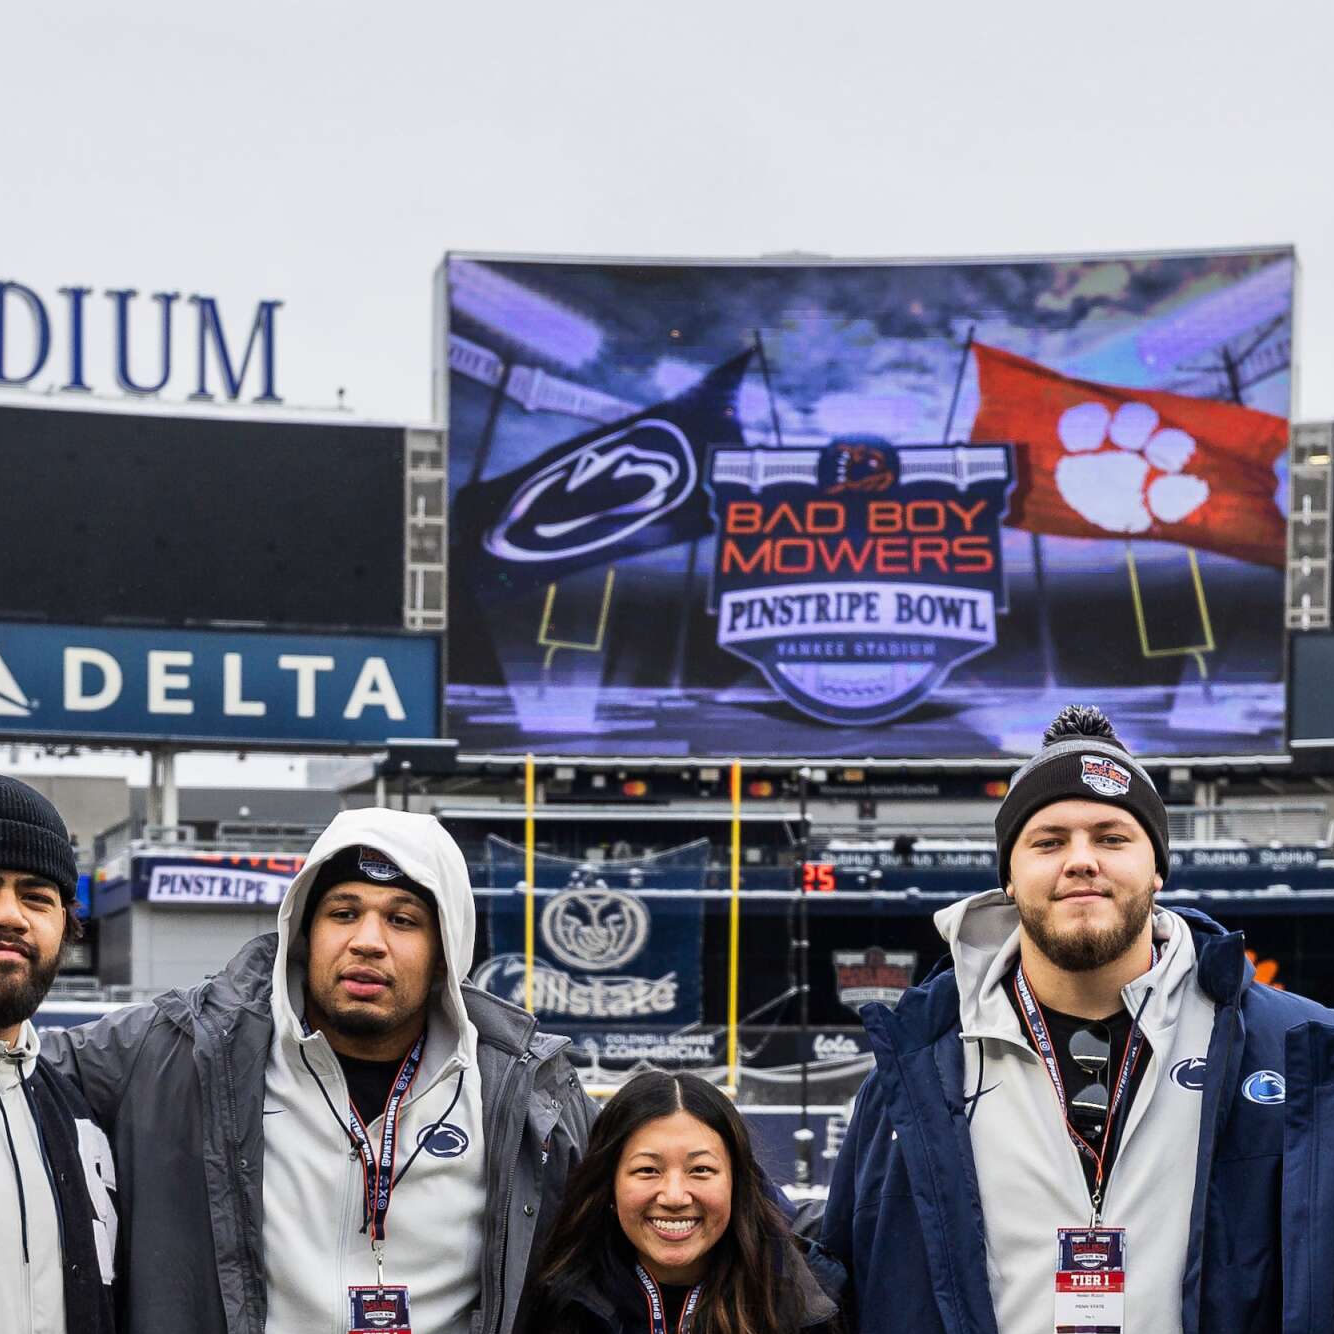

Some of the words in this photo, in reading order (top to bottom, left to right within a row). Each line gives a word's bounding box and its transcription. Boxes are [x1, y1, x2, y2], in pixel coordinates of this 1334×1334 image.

[726, 501, 845, 534] BAD
[868, 501, 988, 534] BOY
[721, 537, 995, 575] MOWERS
[728, 591, 881, 630] PINSTRIPE
[894, 591, 988, 634] BOWL
[853, 640, 936, 656] STADIUM
[64, 647, 407, 721] DELTA
[156, 874, 267, 901] PINSTRIPE
[1070, 1274, 1101, 1286] TIER
[1104, 1275, 1109, 1286] 1
